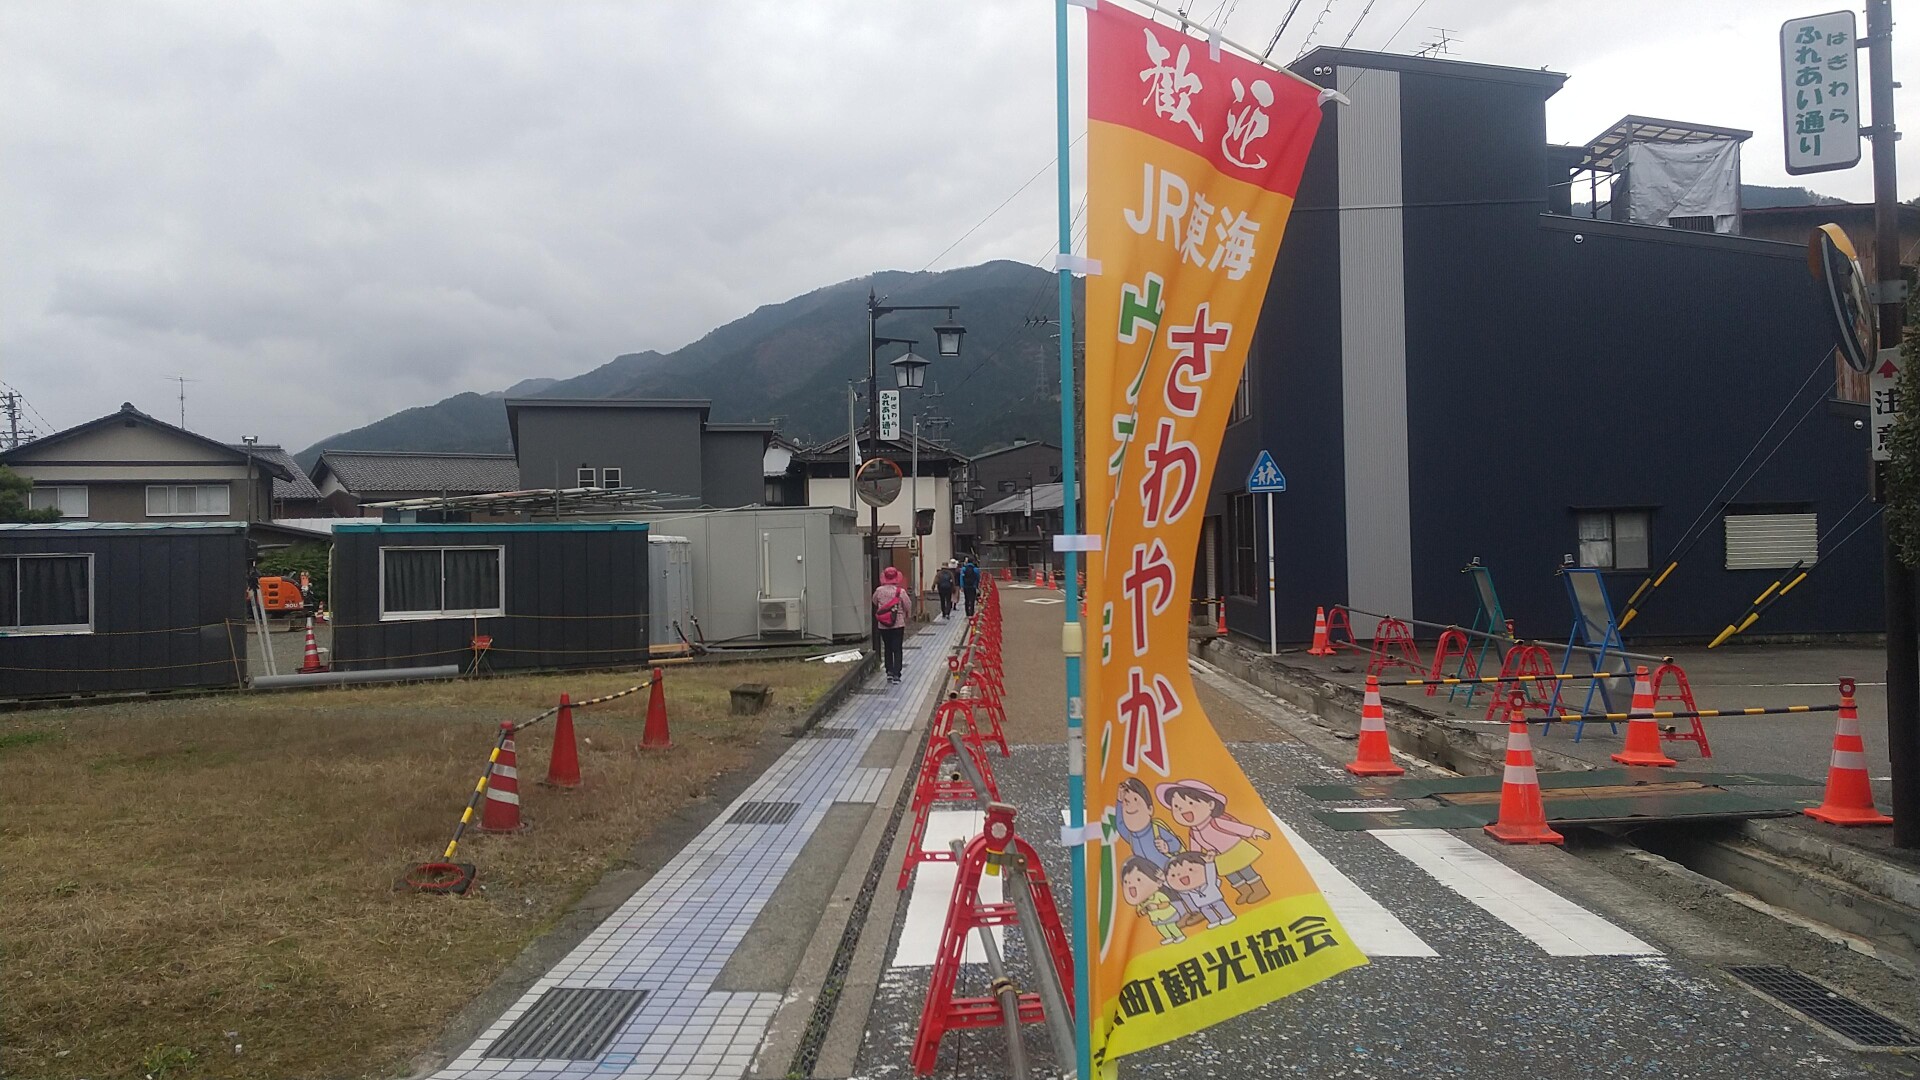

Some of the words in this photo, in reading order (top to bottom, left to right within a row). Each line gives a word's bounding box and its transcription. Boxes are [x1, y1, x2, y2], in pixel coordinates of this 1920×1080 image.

[1139, 28, 1274, 169] 歓迎
[1795, 26, 1825, 156] ふれあい通り
[1826, 32, 1849, 124] はぎわら
[1123, 163, 1260, 281] JR東海
[882, 393, 890, 437] ふれあい通り
[1118, 302, 1233, 776] さわやか
[1112, 915, 1339, 1026] 町観光協会
